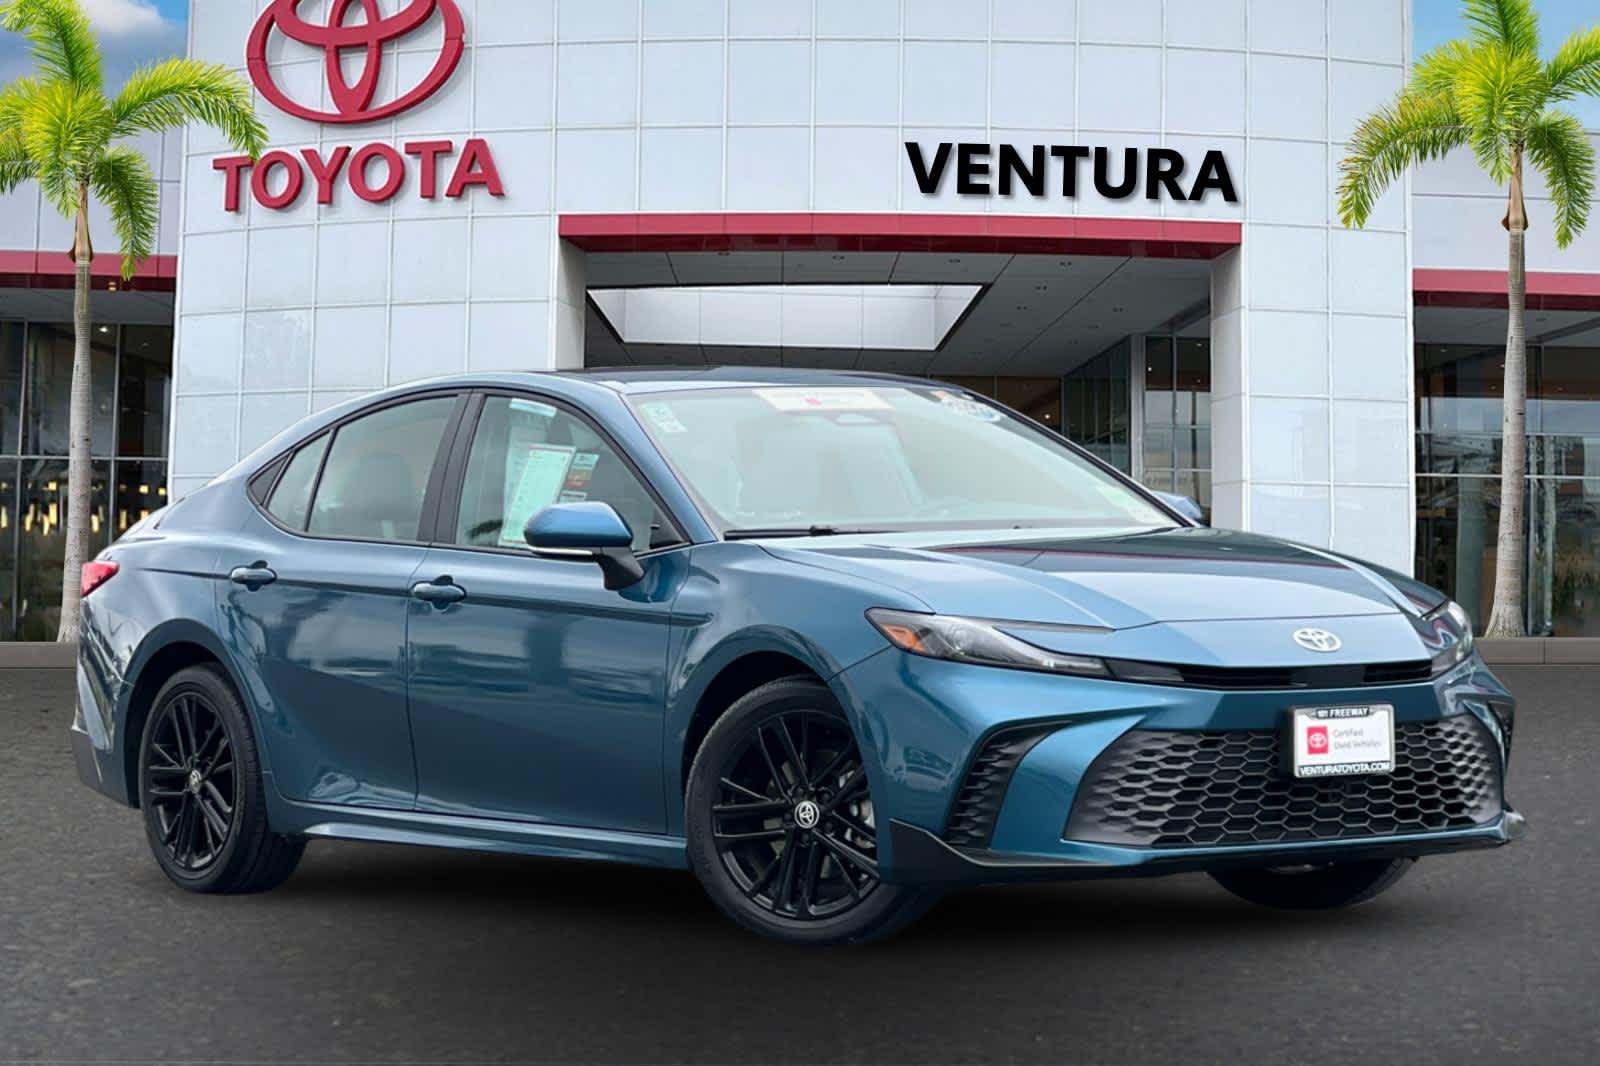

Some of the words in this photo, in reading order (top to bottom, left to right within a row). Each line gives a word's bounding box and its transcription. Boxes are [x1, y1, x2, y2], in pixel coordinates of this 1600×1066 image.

[212, 138, 505, 212] TOYOTA
[904, 141, 1239, 203] VENTURA
[1330, 707, 1368, 718] FREEWAY
[1300, 762, 1390, 776] VENTURATOYOTA.COM
